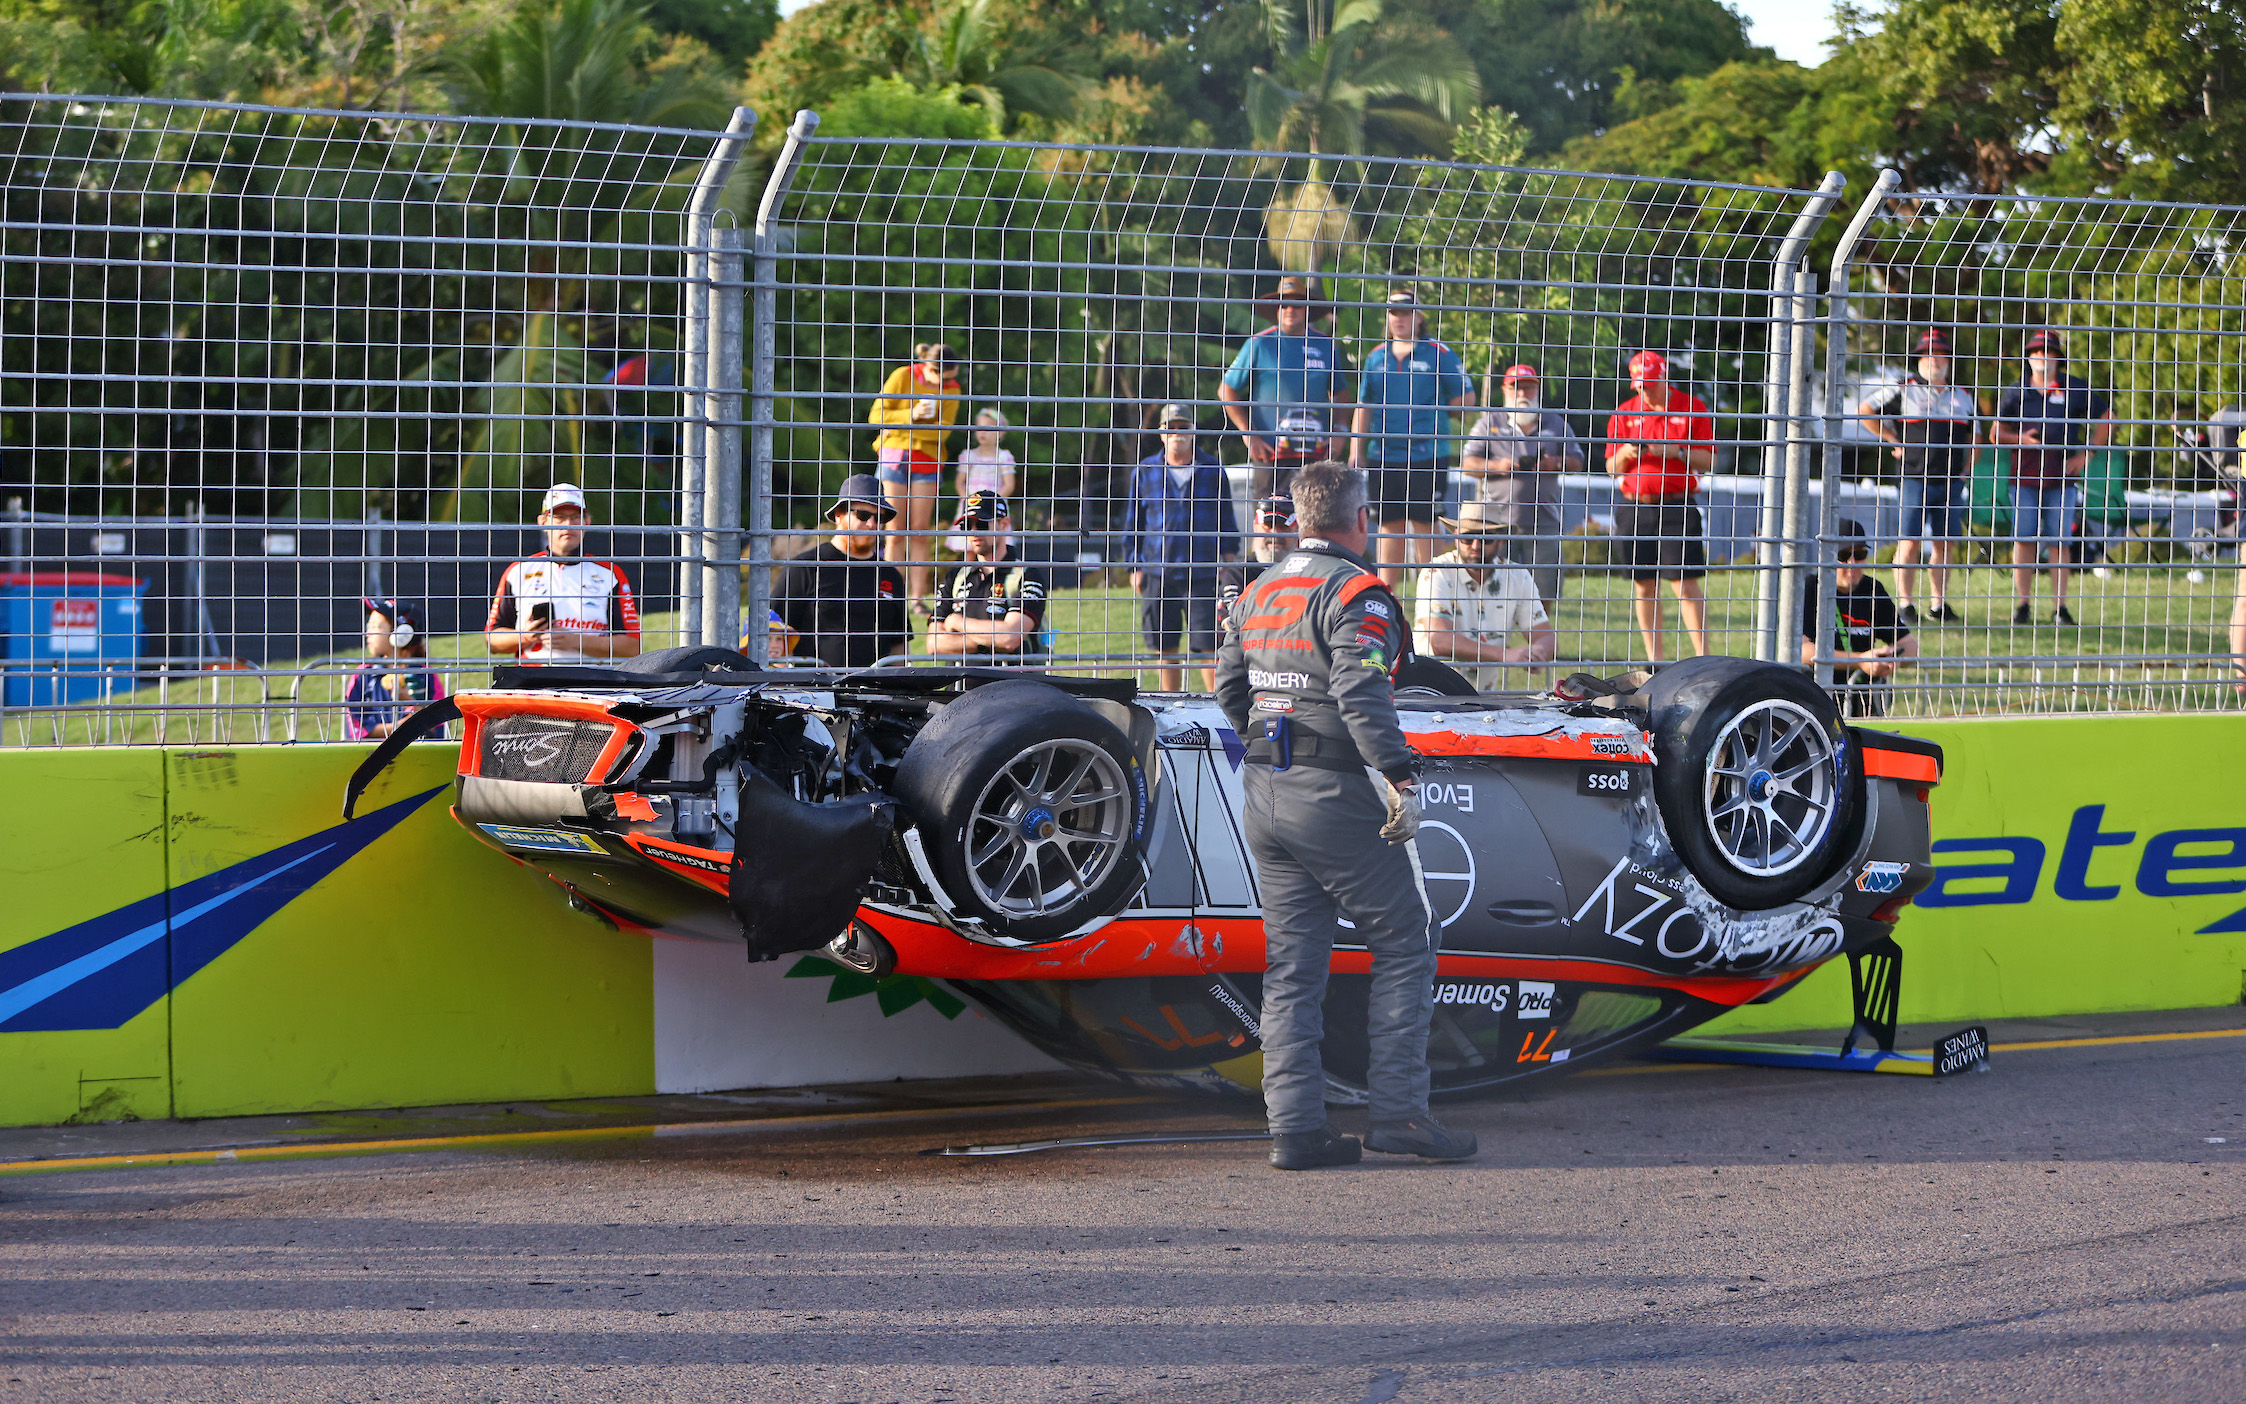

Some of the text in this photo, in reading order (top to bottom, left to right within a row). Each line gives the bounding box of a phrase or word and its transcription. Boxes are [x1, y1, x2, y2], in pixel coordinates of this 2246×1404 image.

[1365, 601, 1388, 617] OMP
[556, 617, 608, 631] atteries
[1242, 638, 1313, 651] SUPERCARS
[1248, 669, 1310, 689] RECOVERY
[1259, 700, 1290, 710] raceline
[1417, 782, 1474, 813] Evol
[497, 830, 561, 845] MICHELIN
[1209, 984, 1260, 1038] MotorsportAU
[1518, 991, 1552, 1011] PRO
[1517, 1029, 1558, 1063] 71
[1944, 1029, 1979, 1056] WINES
[1941, 1041, 1985, 1074] AMADIO
